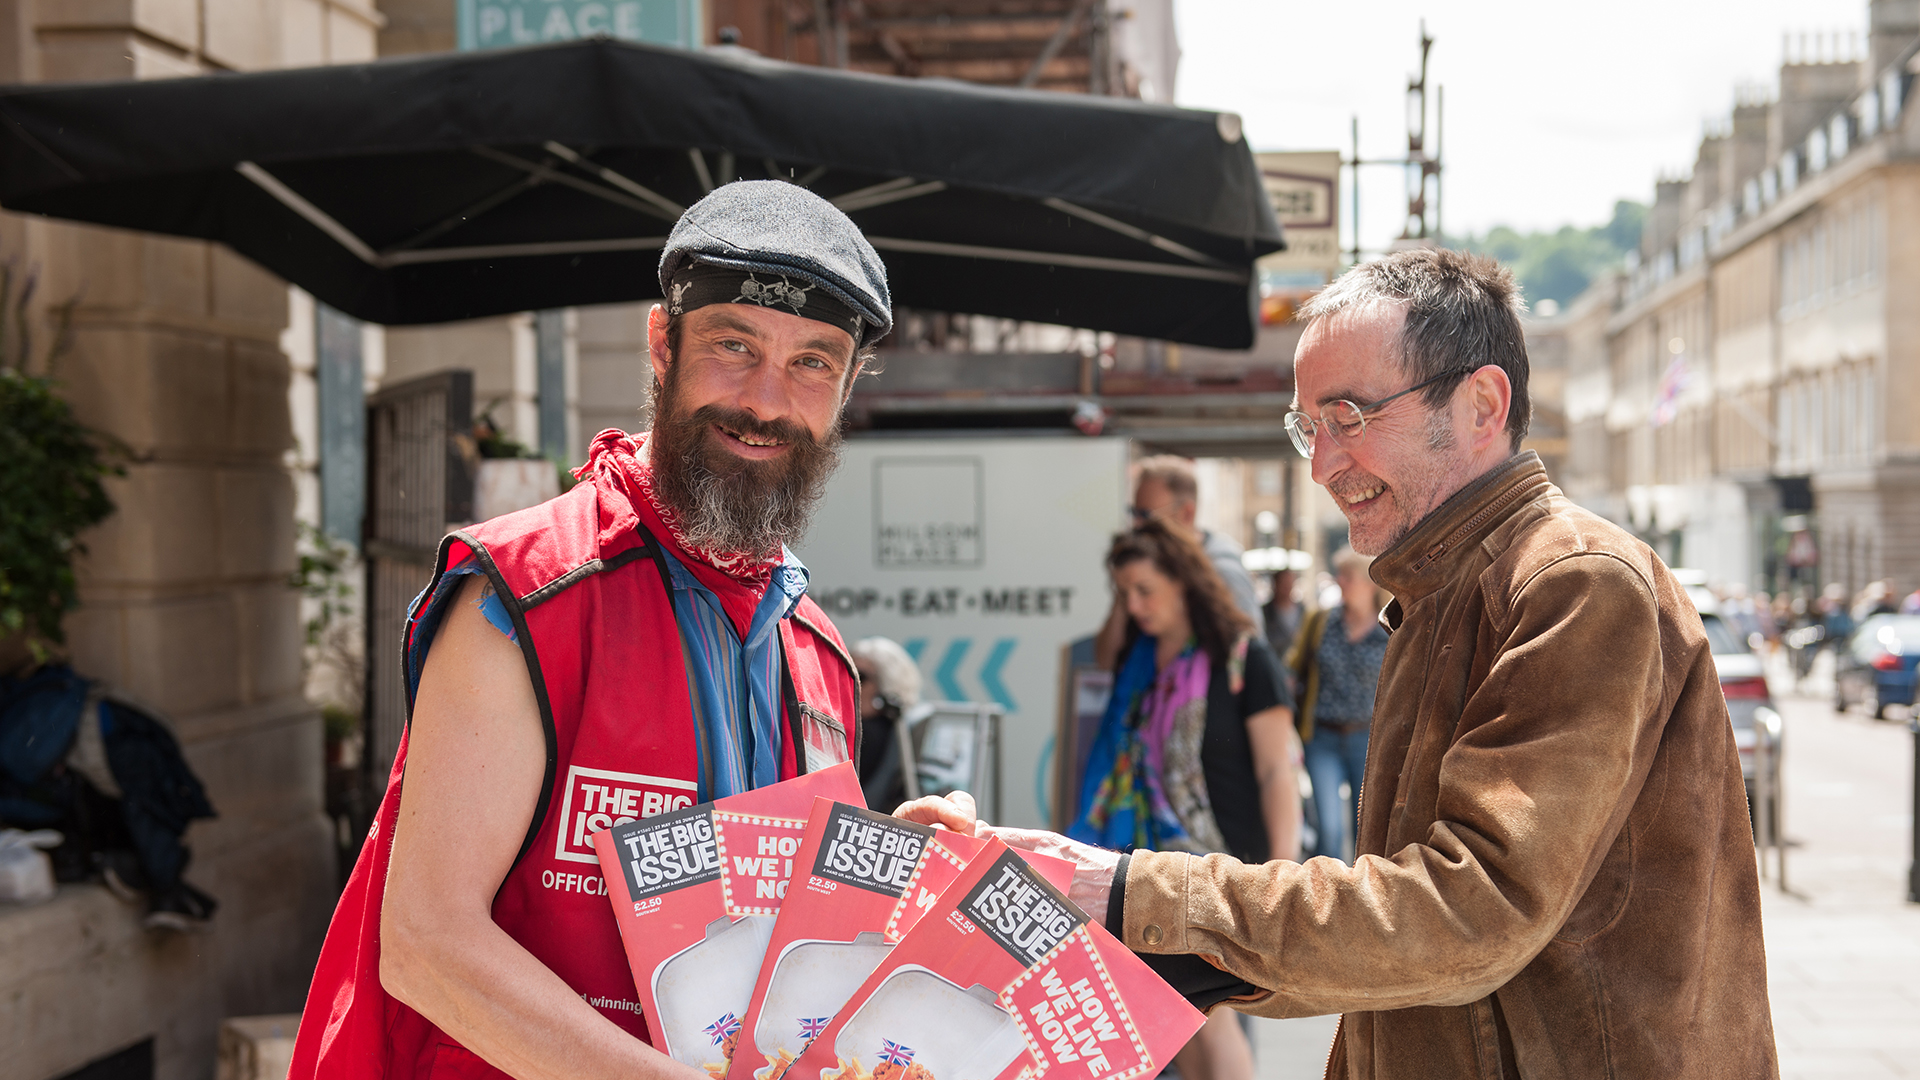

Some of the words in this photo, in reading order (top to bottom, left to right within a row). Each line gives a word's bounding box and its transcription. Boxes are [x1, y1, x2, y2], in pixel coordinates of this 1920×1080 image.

[478, 2, 642, 44] PLACE
[879, 545, 958, 560] PLACE
[900, 588, 960, 616] EAT
[982, 588, 1074, 616] MEET
[580, 783, 642, 815] THE
[642, 790, 693, 816] BIG
[624, 829, 674, 860] THE
[672, 820, 712, 848] BIG
[758, 836, 802, 857] HO
[837, 819, 883, 851] THE
[880, 832, 921, 859] BIG
[631, 840, 721, 888] ISSUE
[733, 856, 779, 877] WE
[809, 877, 837, 891] £2.50
[824, 840, 916, 888] ISSUE
[634, 897, 662, 912] £2.50
[951, 910, 976, 932] £2.50
[972, 884, 1058, 961] ISSUE
[995, 866, 1041, 913] THE
[1029, 899, 1070, 939] BIG
[590, 995, 642, 1015] winning
[1040, 967, 1077, 1016] WE
[1063, 1013, 1111, 1078] LIVE
[1070, 977, 1120, 1042] HOW
[1030, 1000, 1080, 1064] NOW
